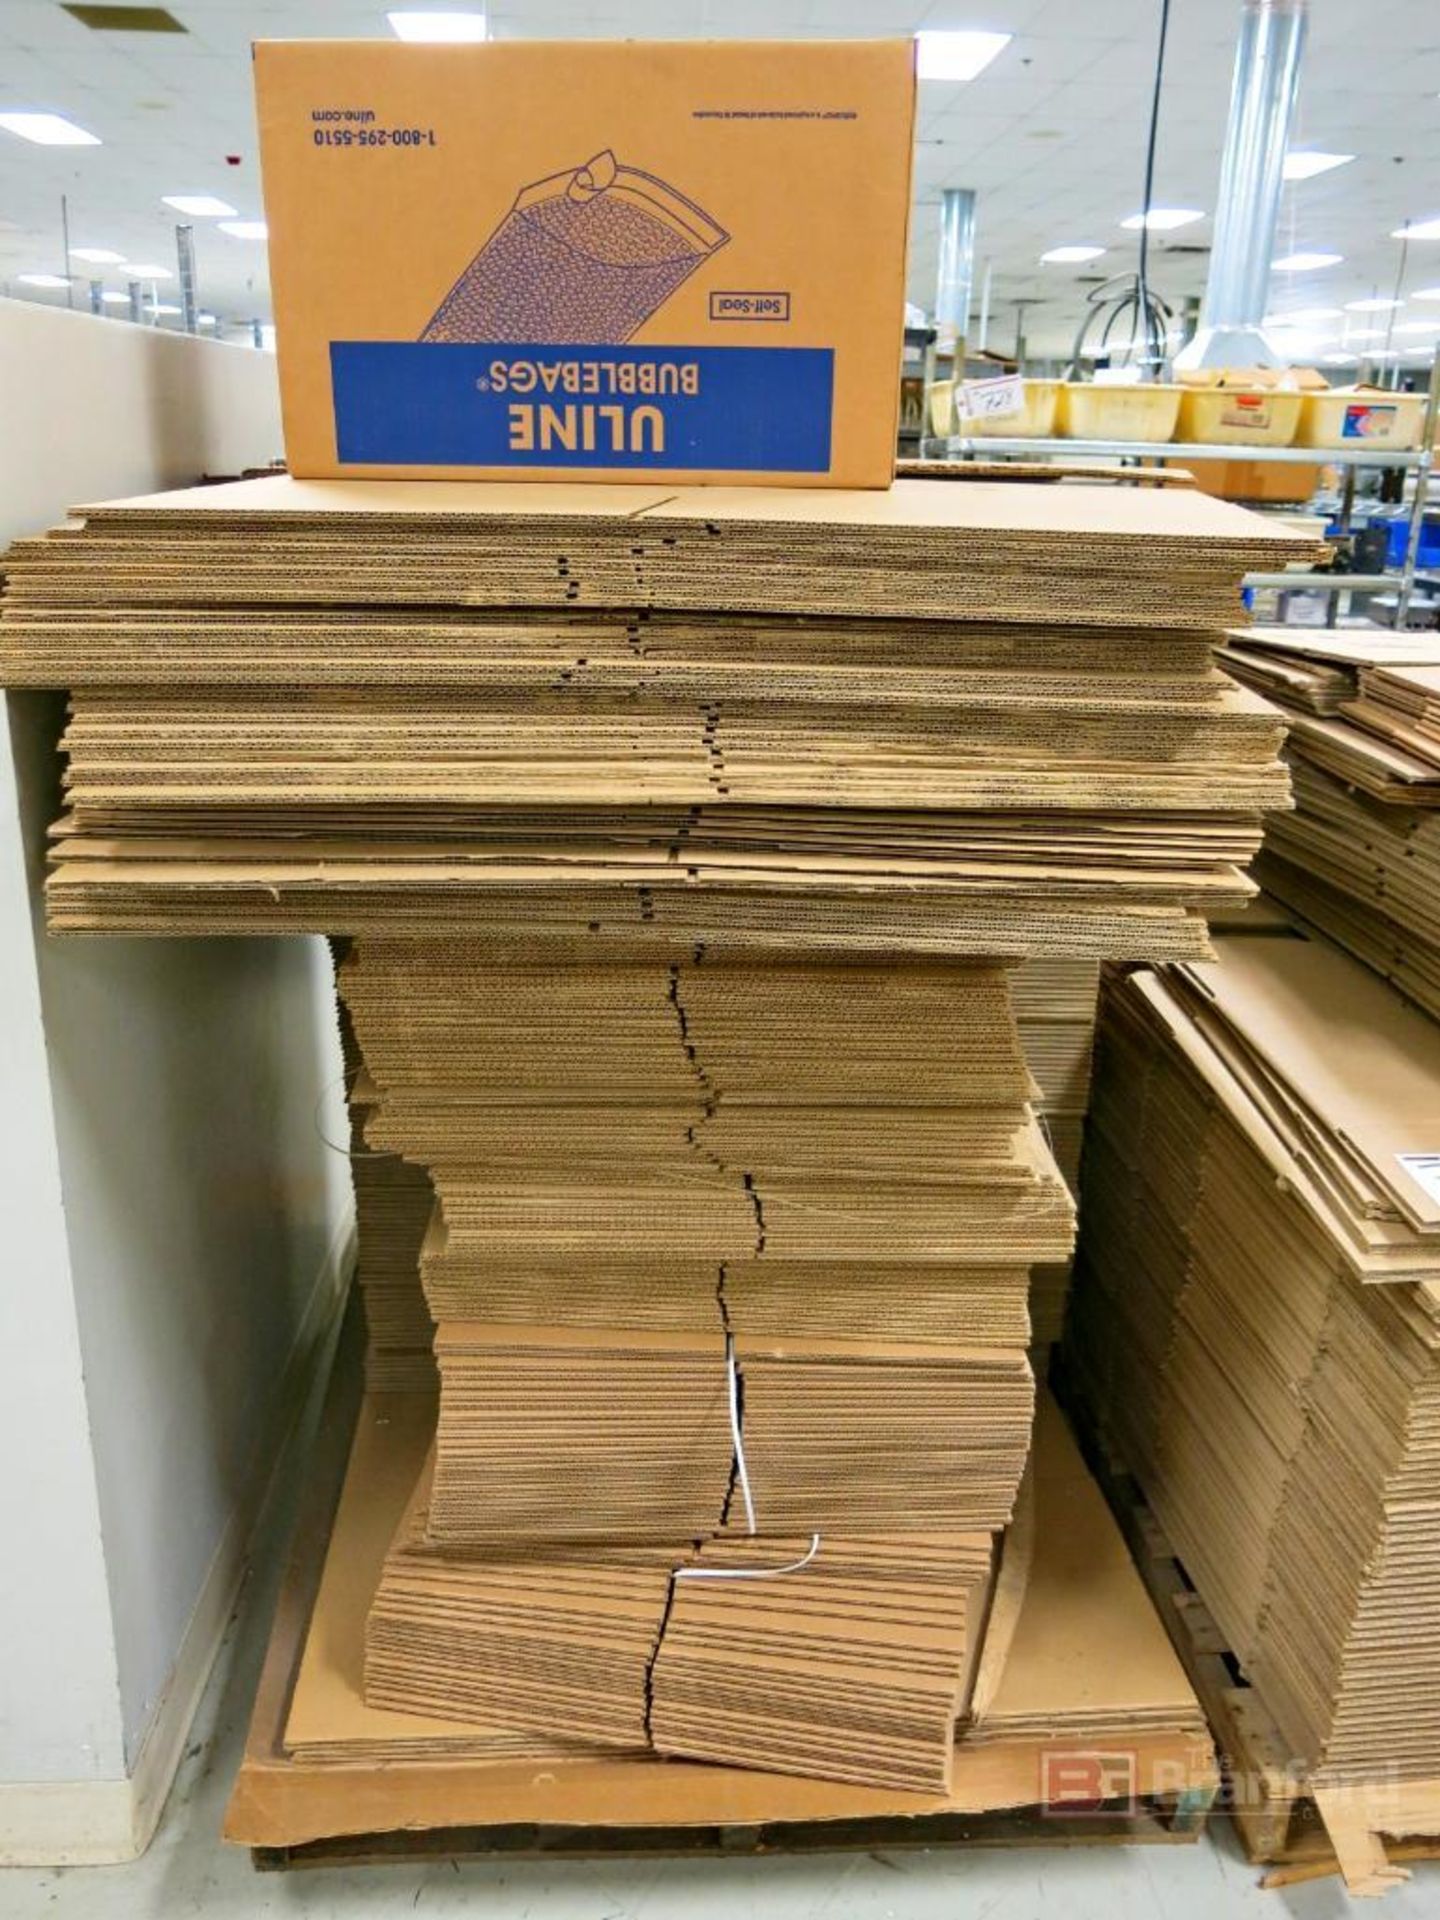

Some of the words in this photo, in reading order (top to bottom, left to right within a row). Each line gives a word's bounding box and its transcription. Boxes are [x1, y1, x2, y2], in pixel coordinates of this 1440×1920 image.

[312, 111, 375, 124] uline.com
[313, 129, 436, 146] 1-800-295-5510
[719, 299, 781, 314] Self-Seal
[508, 403, 666, 452] ULINE
